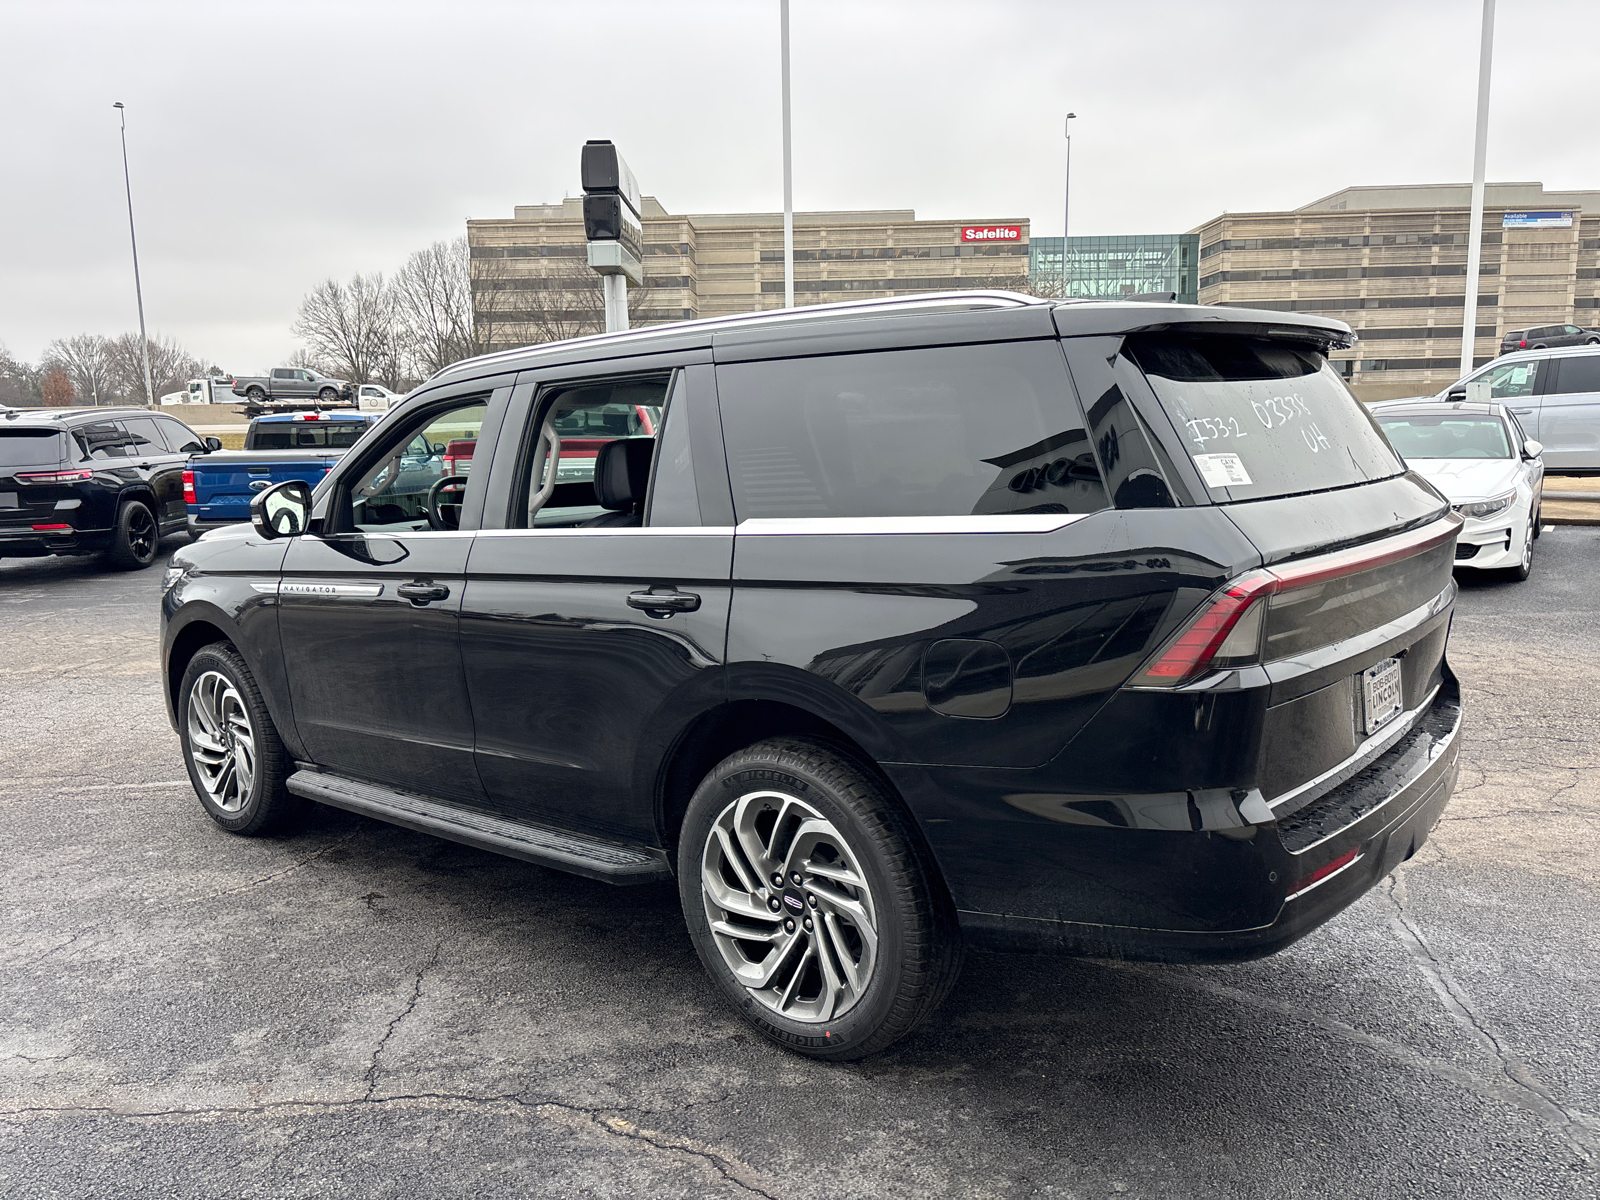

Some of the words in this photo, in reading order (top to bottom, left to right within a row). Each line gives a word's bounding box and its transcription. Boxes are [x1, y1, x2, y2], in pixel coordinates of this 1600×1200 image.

[965, 228, 1018, 240] Safelite
[283, 585, 336, 594] NAVIGATOR
[1372, 681, 1400, 709] LINCOLN
[739, 769, 810, 792] MICHELIN
